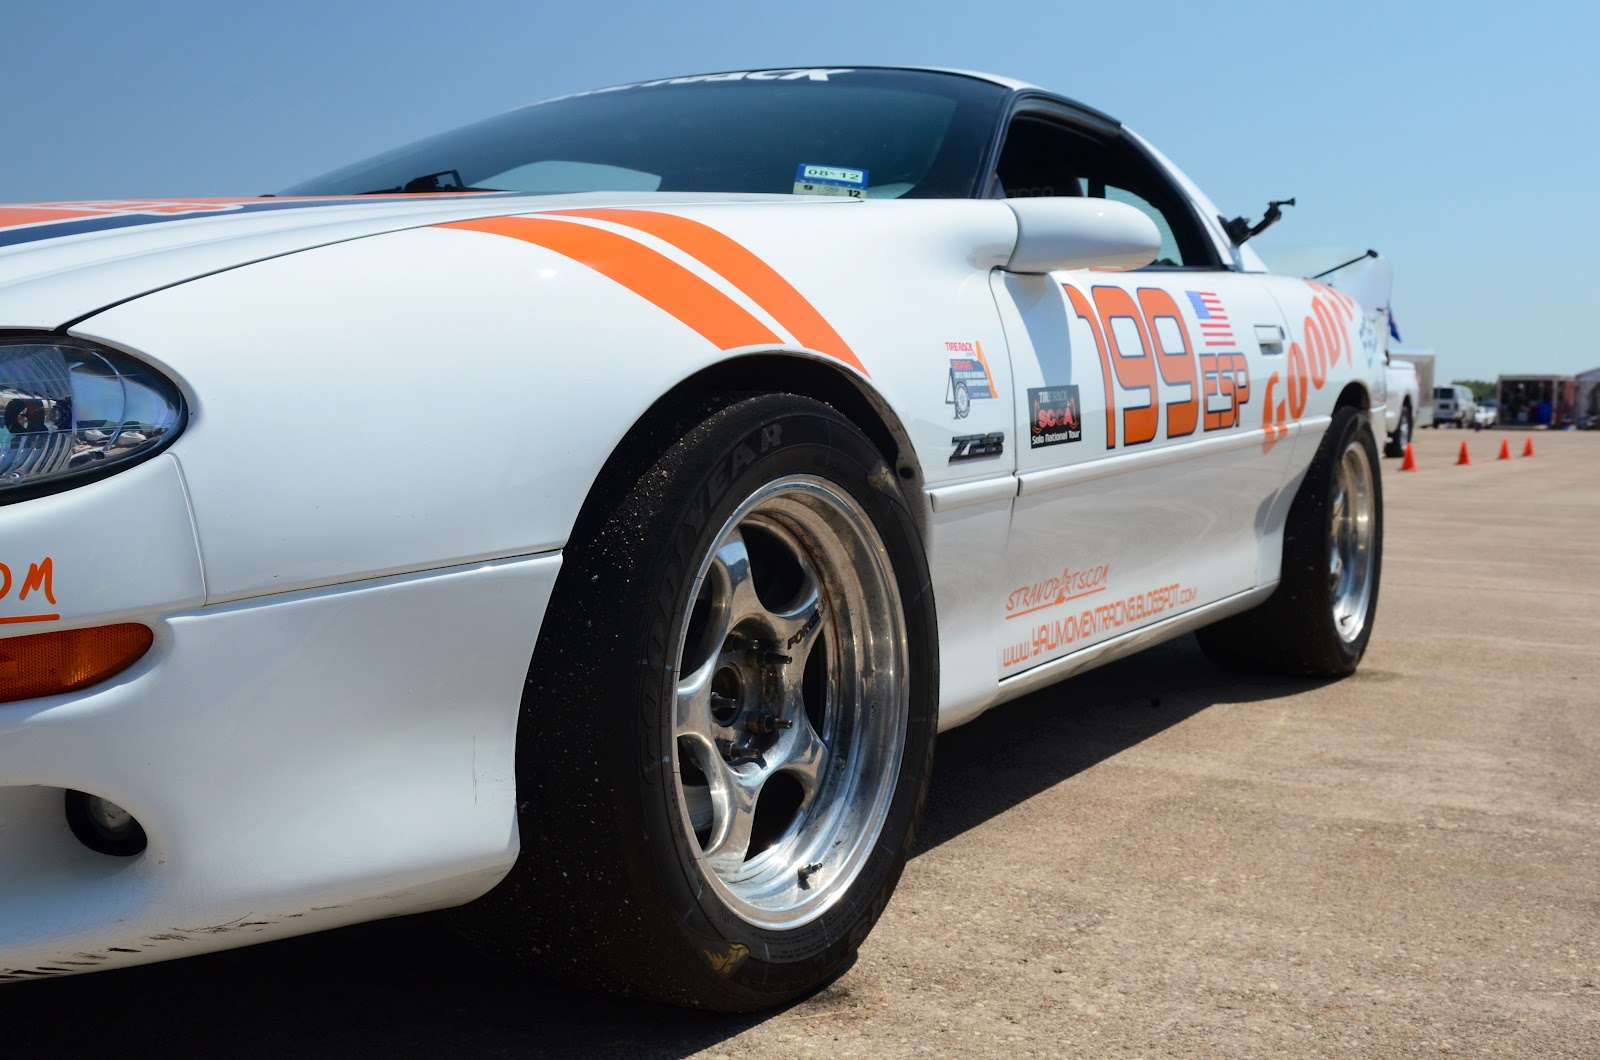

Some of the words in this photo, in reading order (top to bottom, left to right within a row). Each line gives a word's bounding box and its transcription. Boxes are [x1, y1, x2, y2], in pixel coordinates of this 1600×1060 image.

[847, 189, 861, 198] 12
[1061, 283, 1199, 450] 199
[1199, 353, 1250, 432] ESP
[1038, 407, 1074, 428] SCCA
[949, 431, 1005, 463] Z28
[1032, 435, 1045, 445] Solo
[1068, 430, 1081, 439] Tour
